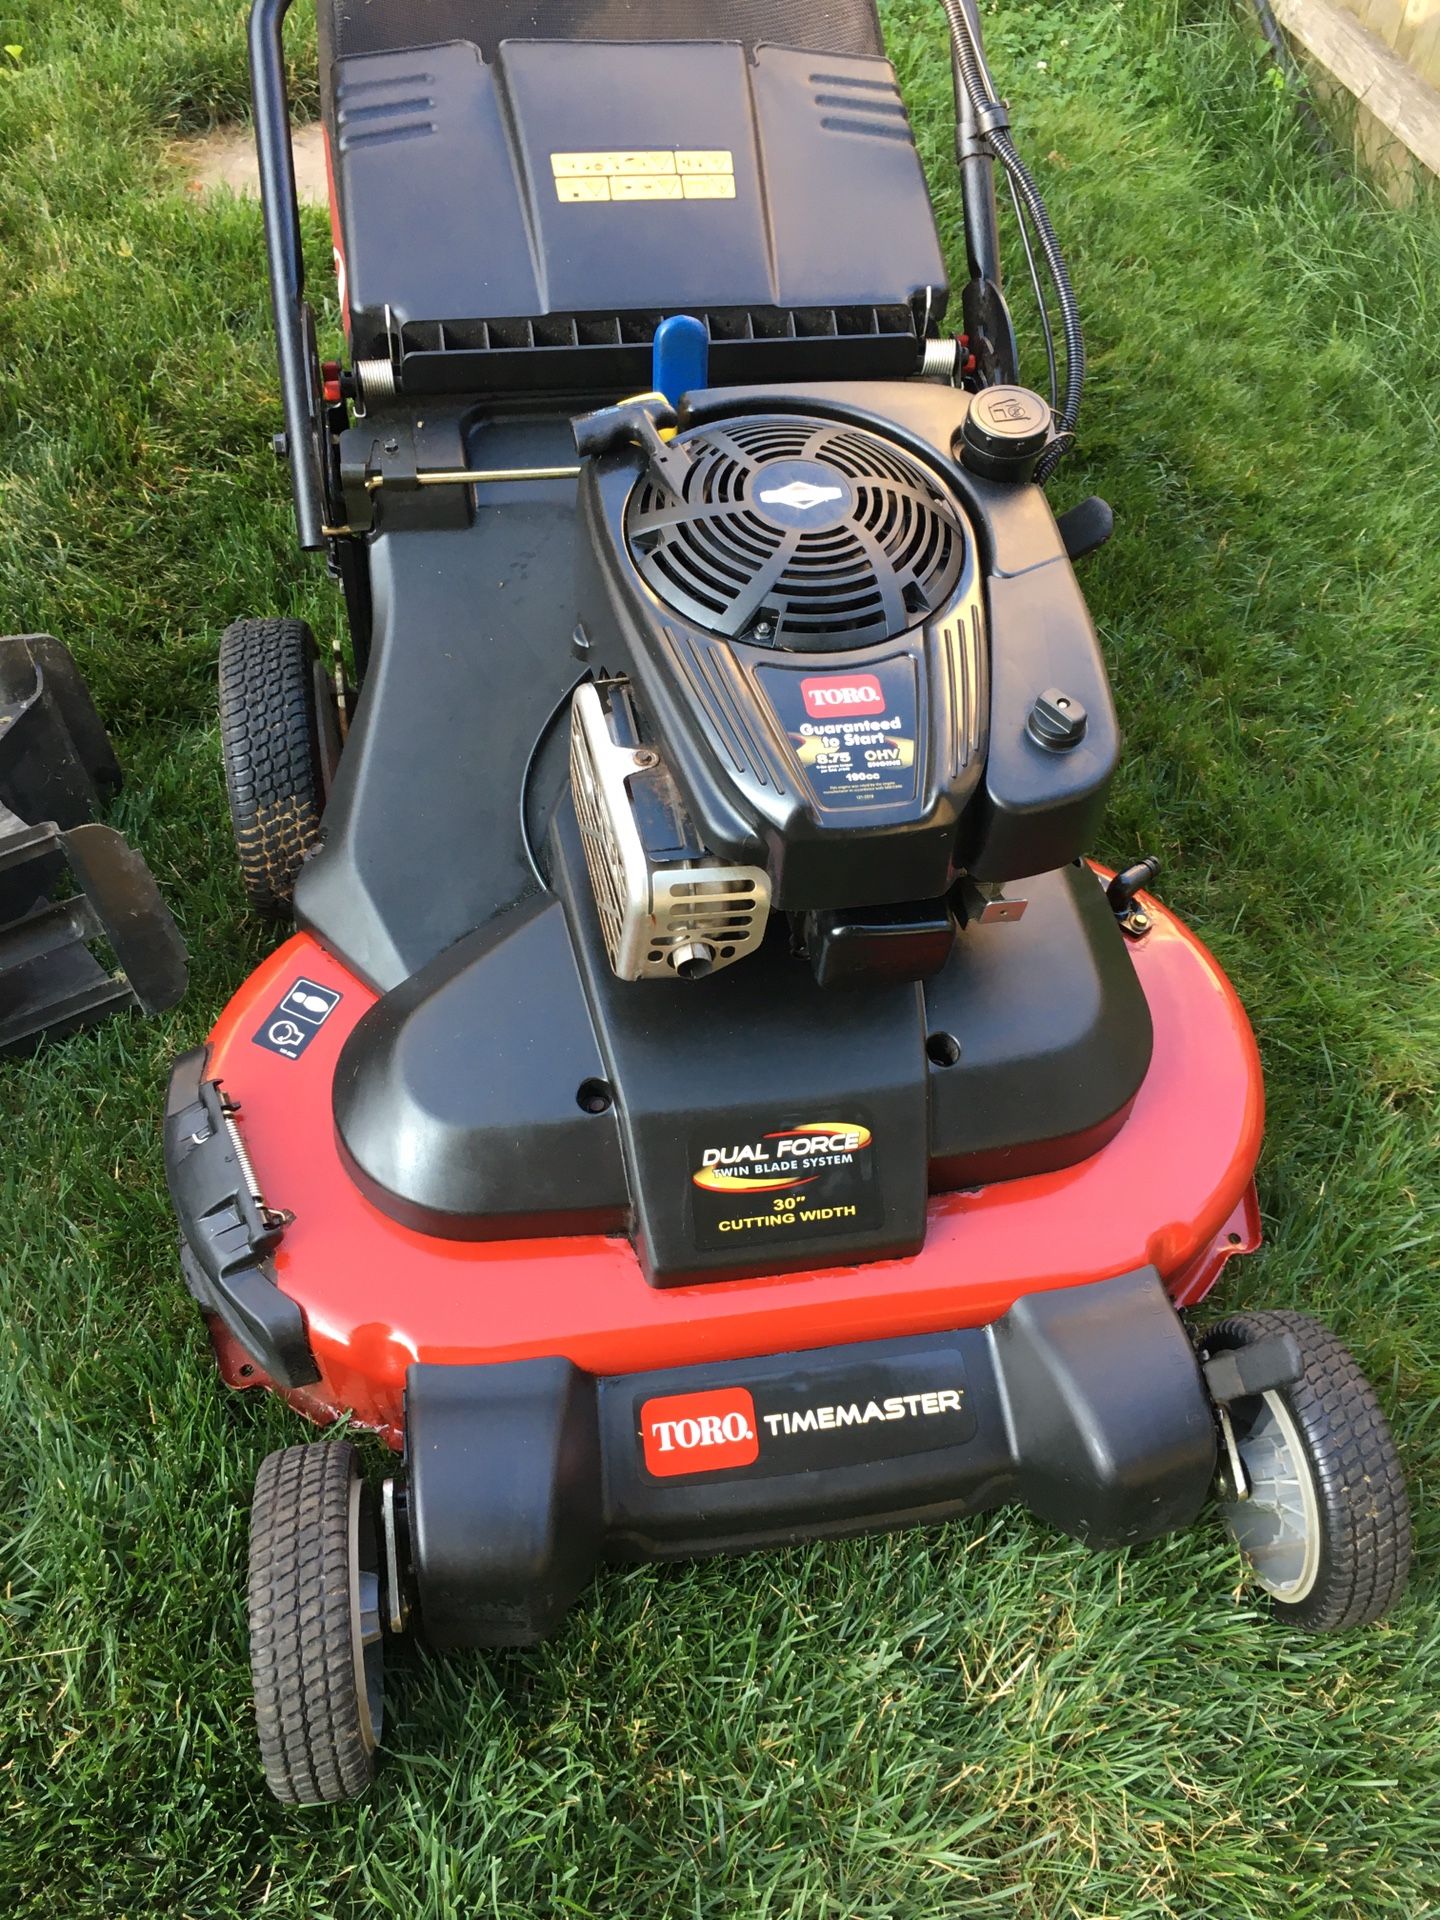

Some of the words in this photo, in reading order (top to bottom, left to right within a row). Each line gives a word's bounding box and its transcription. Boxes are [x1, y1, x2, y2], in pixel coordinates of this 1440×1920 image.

[800, 716, 902, 736] Guaranteed
[821, 736, 840, 749] to
[844, 732, 885, 747] Start
[816, 752, 851, 765] 8.75
[864, 749, 899, 761] OHV
[702, 1144, 770, 1167] DUAL
[776, 1131, 861, 1158] FORCE
[712, 1165, 750, 1179] TWIN
[755, 1159, 798, 1175] BLADE
[802, 1153, 854, 1169] SYSTEM
[718, 1212, 796, 1232] CUTTING
[799, 1205, 857, 1223] WIDTH
[763, 1389, 962, 1437] TIMEMASTER
